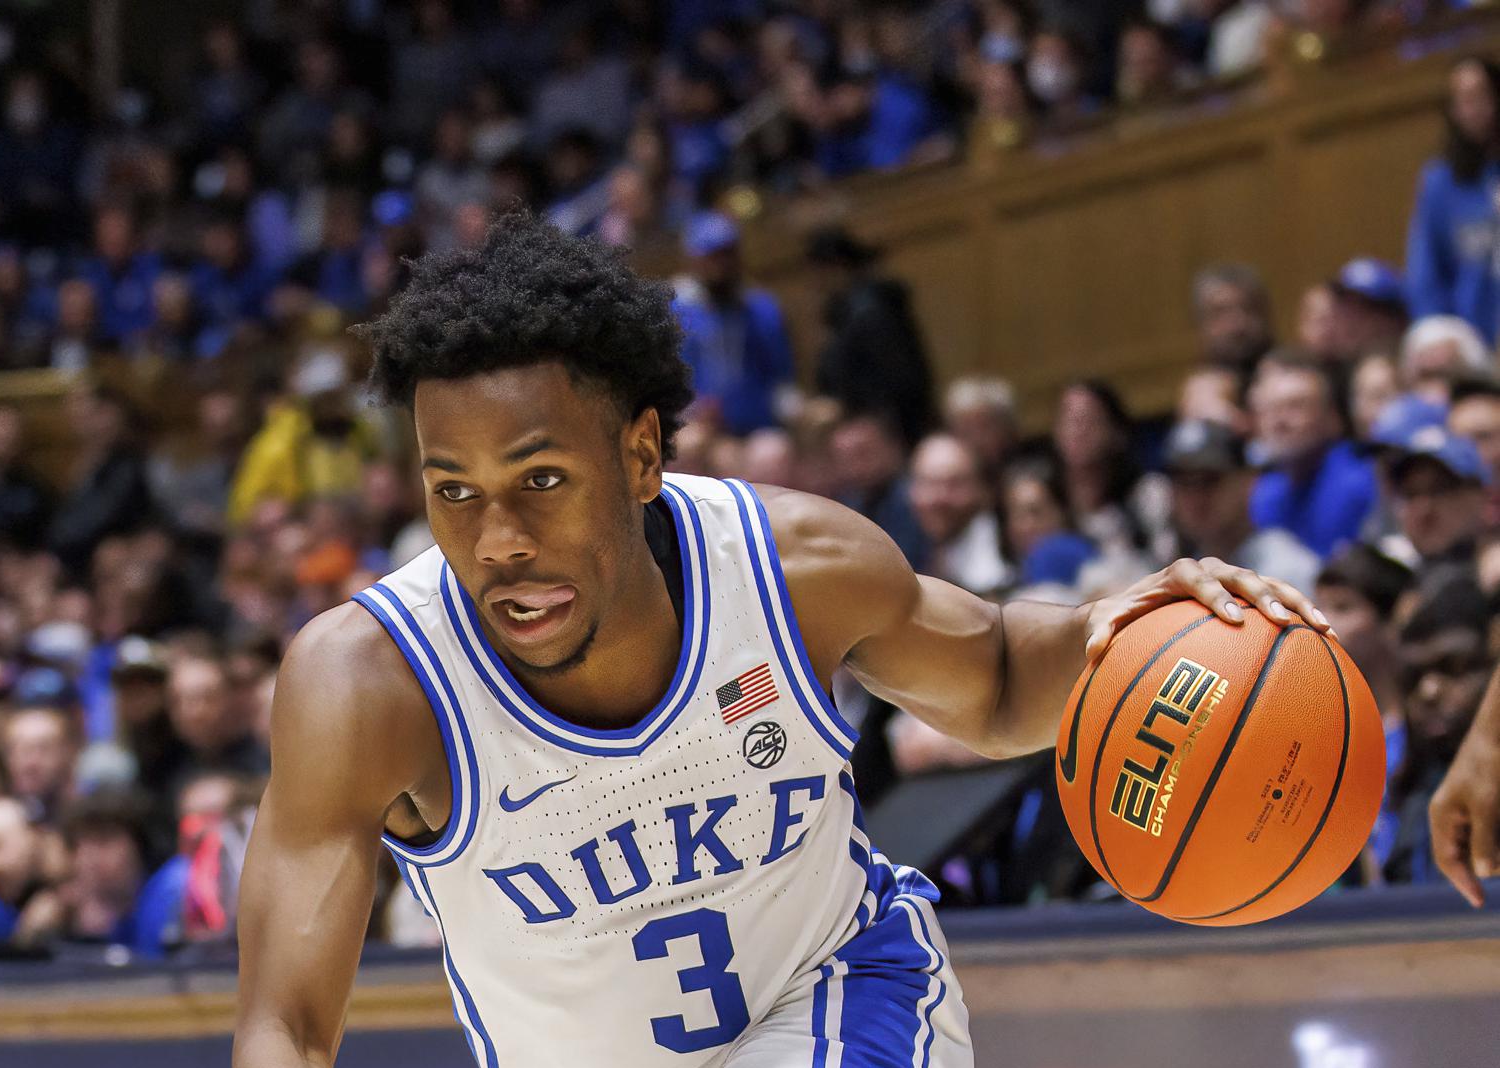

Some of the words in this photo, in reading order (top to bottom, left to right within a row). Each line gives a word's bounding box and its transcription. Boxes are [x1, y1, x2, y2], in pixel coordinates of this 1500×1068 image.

[748, 728, 783, 757] ACC
[481, 775, 826, 923] DUKE
[631, 907, 751, 1054] 3
